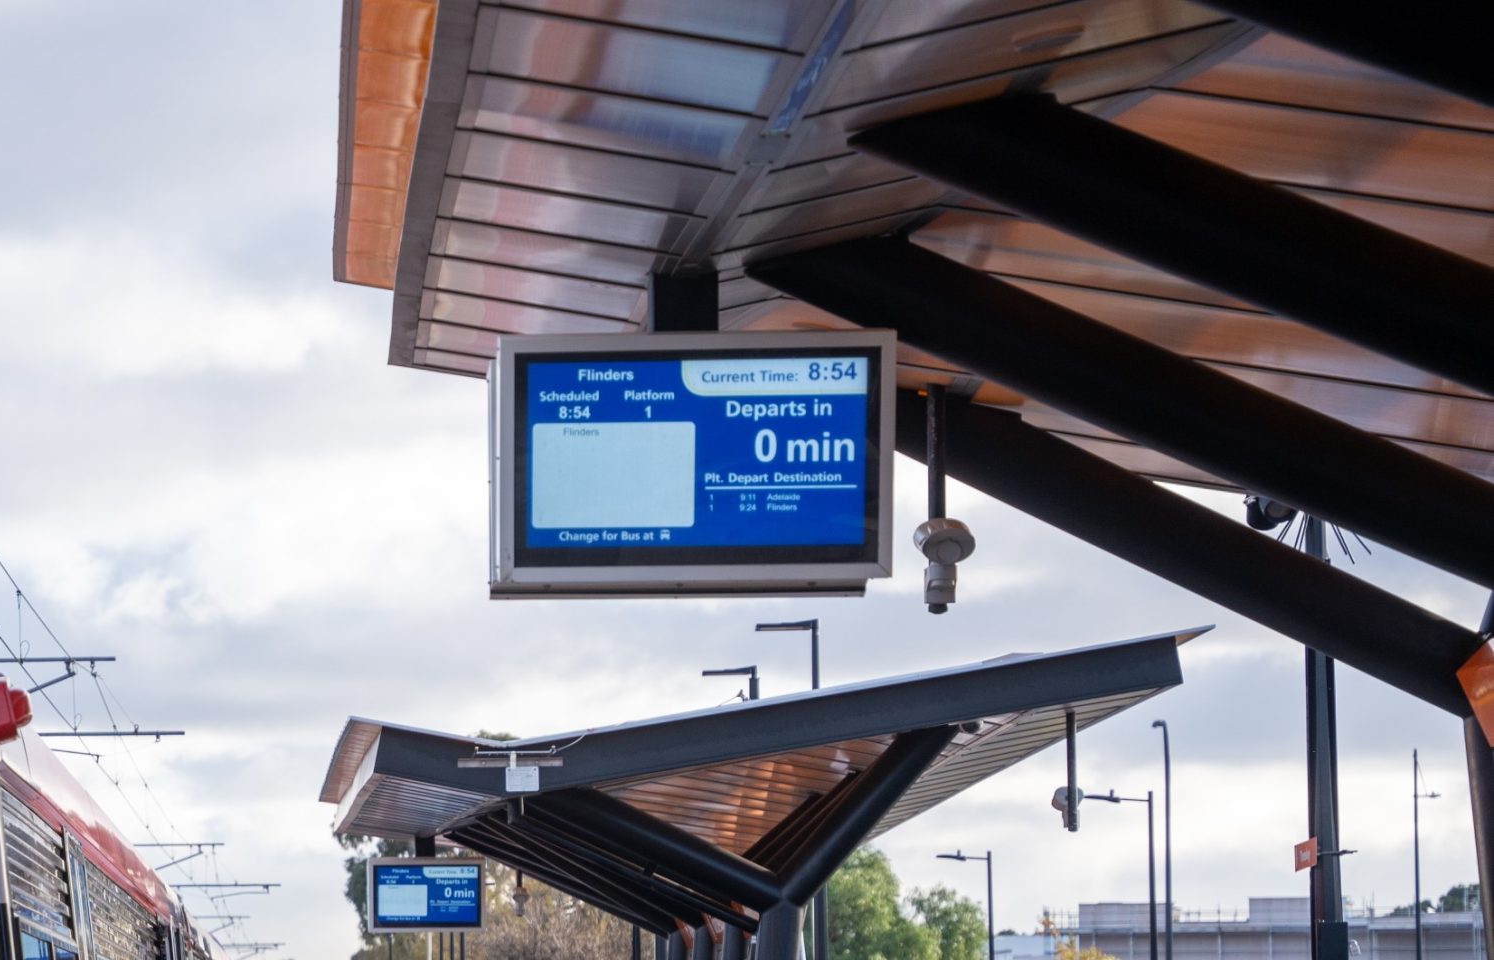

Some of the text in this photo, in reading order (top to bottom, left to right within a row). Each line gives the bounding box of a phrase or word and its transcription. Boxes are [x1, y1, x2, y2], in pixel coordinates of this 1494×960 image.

[578, 369, 634, 381] Flinders
[701, 361, 858, 383] Current Time: 8:54
[539, 390, 600, 402] Scheduled
[624, 390, 675, 401] Platform
[558, 406, 591, 419] 8:54
[644, 405, 652, 419] 1
[726, 398, 833, 421] Departs in
[563, 427, 599, 436] Flinders
[754, 428, 855, 462] 0 min
[705, 471, 842, 485] Plt. Depart Destination
[767, 493, 800, 501] Adelaide
[767, 503, 798, 511] Flinders
[559, 530, 654, 543] Change for Bus at
[444, 887, 475, 898] 0 min
